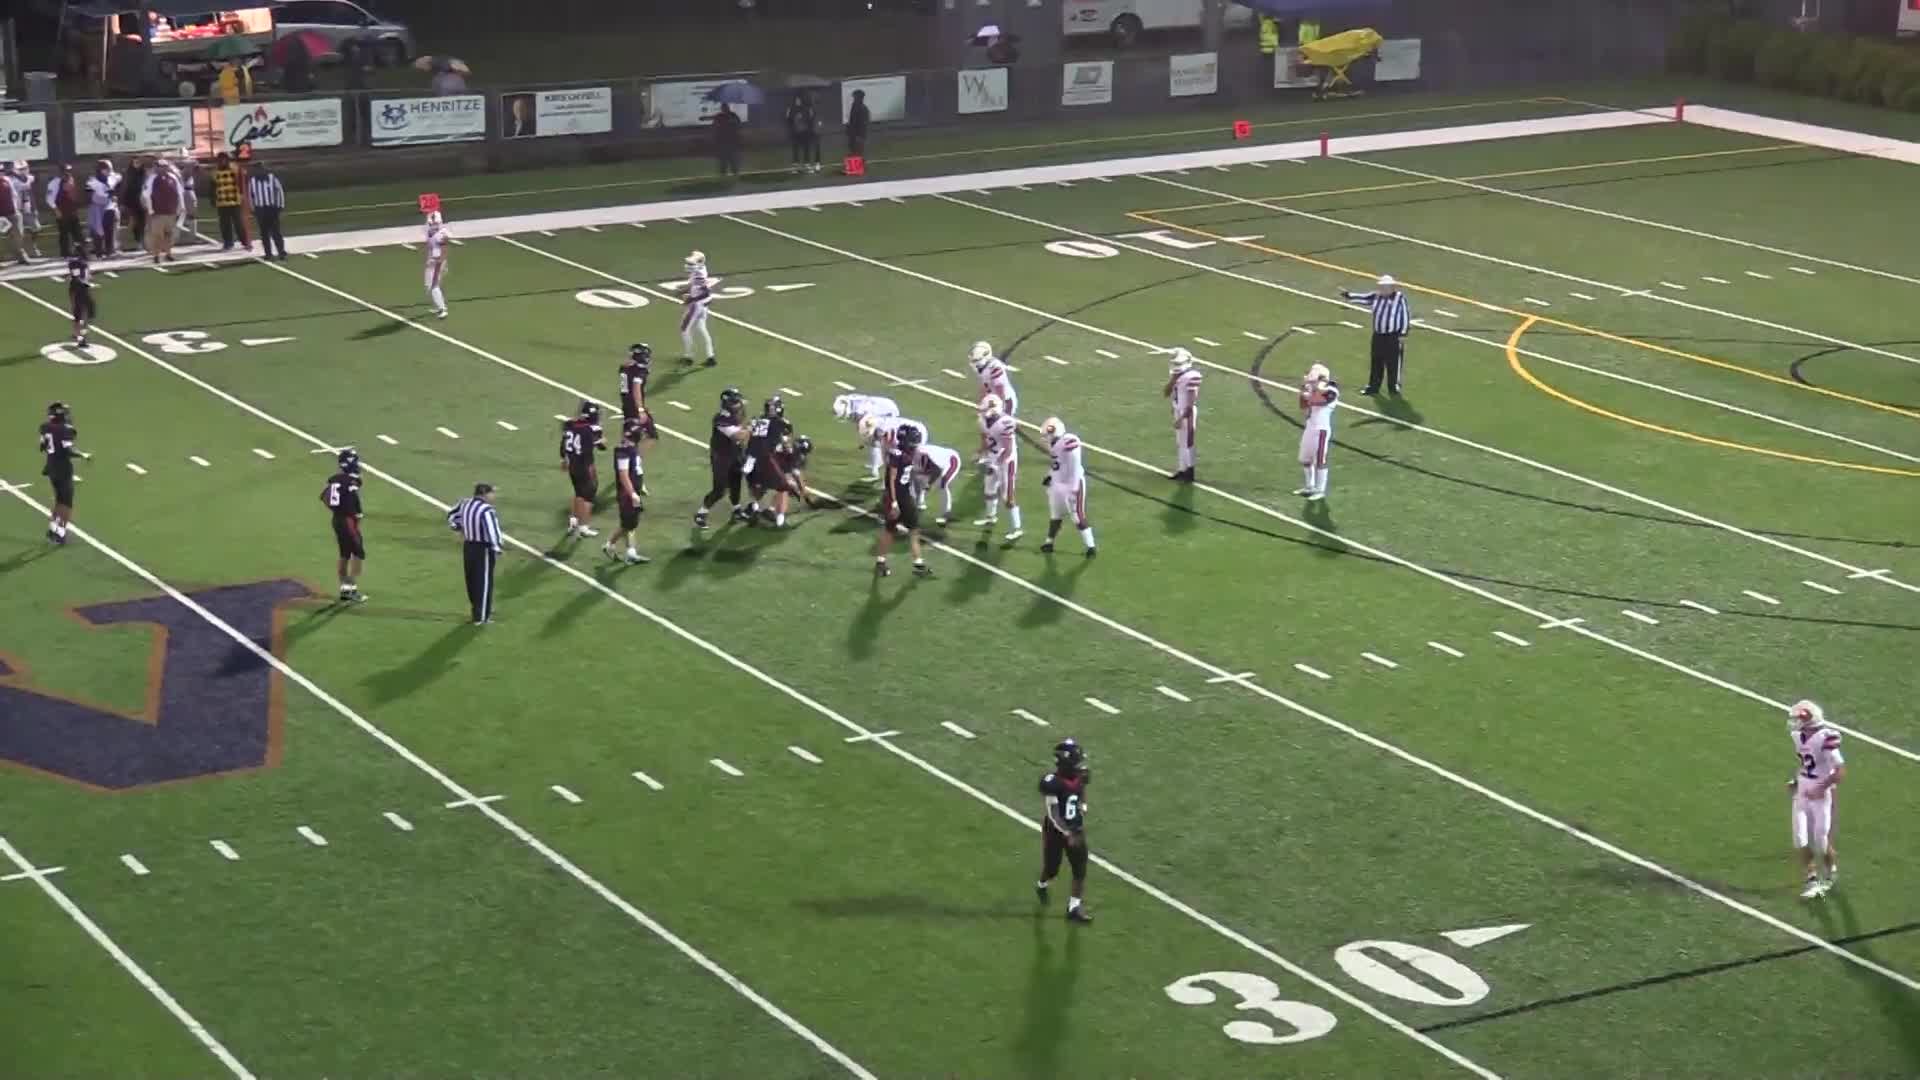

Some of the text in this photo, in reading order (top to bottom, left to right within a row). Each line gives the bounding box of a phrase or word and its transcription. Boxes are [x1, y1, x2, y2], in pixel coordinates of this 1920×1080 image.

[0, 128, 43, 148] .org
[565, 431, 582, 455] 24
[1065, 794, 1079, 820] 6
[1164, 940, 1490, 1044] 30
